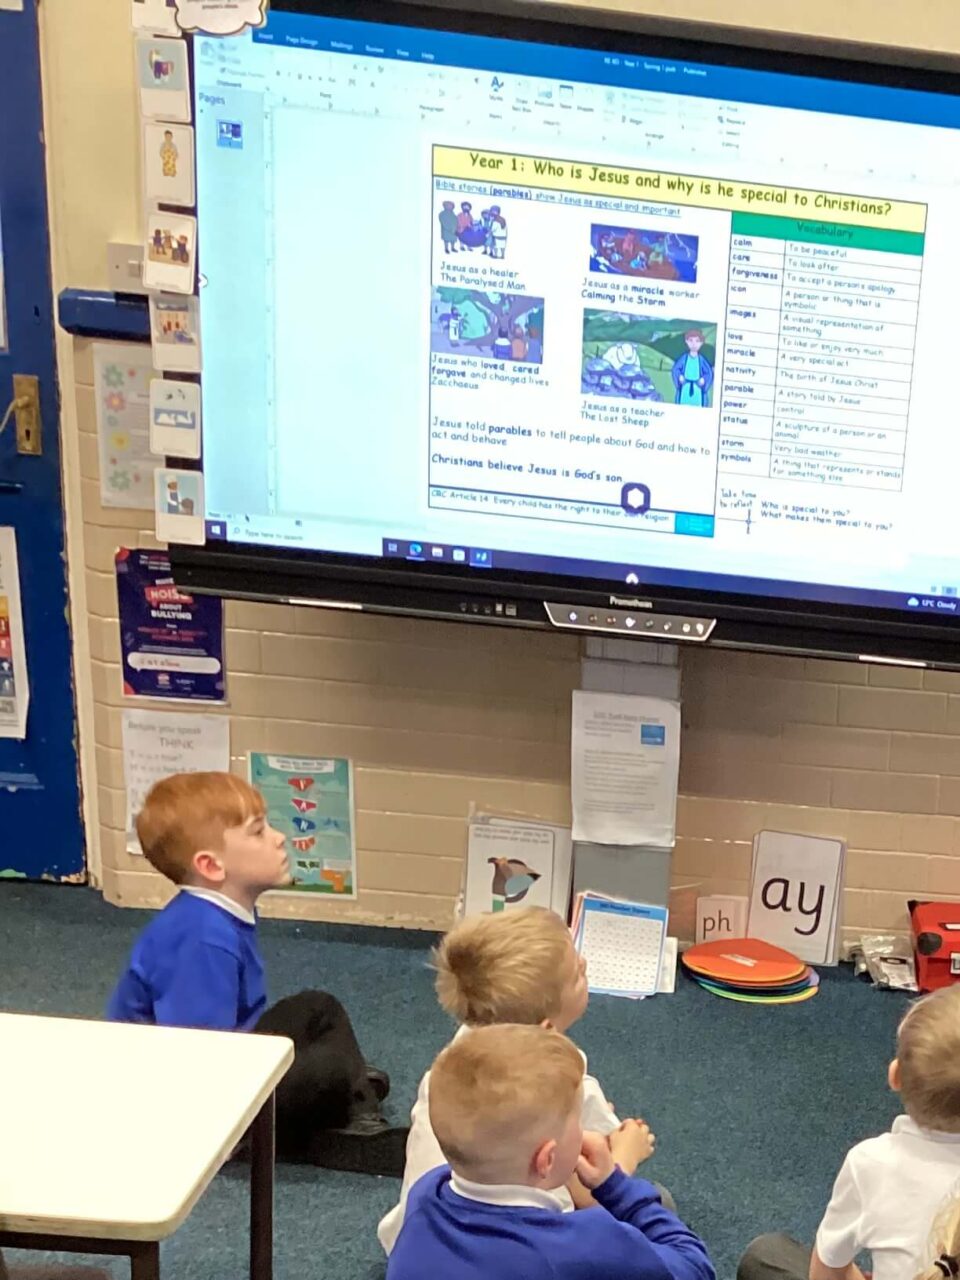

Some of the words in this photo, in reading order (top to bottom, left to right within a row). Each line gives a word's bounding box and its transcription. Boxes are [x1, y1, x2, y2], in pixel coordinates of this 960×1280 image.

[200, 93, 225, 106] Pages
[470, 152, 503, 169] Year
[511, 158, 524, 172] 1:
[534, 160, 563, 176] Who
[571, 165, 582, 179] is
[588, 167, 629, 184] Jesus
[636, 175, 660, 188] and
[667, 177, 694, 196] why
[700, 182, 711, 195] is
[718, 182, 733, 197] he
[741, 188, 787, 204] special
[794, 193, 807, 206] to
[814, 195, 892, 216] Christians?
[436, 180, 455, 189] Bible
[459, 182, 487, 193] stories
[560, 194, 581, 204] Jesus
[595, 200, 622, 210] special
[623, 203, 639, 211] and
[797, 222, 854, 240] Vocabulary
[734, 239, 752, 248] calm
[440, 261, 466, 272] Jesus
[490, 266, 518, 278] healer
[732, 268, 778, 281] forgiveness
[441, 273, 456, 283] The
[460, 274, 503, 288] Paralysed
[507, 280, 526, 290] Man
[582, 278, 606, 289] Jesus
[632, 285, 664, 296] miracle
[670, 290, 700, 299] worker
[581, 289, 615, 304] Calming
[618, 294, 633, 303] the
[637, 296, 665, 307] Storm
[432, 354, 458, 364] Jesus
[461, 358, 478, 367] who
[727, 348, 756, 357] miracle
[432, 366, 466, 378] forgave
[470, 370, 487, 380] and
[489, 373, 526, 385] changed
[529, 376, 549, 386] lives
[726, 366, 756, 376] nativity
[432, 377, 479, 390] Zacchaeus
[724, 384, 754, 394] parable
[582, 401, 606, 411] Jesus
[631, 407, 664, 417] teacher
[724, 400, 746, 409] power
[581, 411, 596, 420] The
[600, 412, 618, 422] Lost
[622, 416, 649, 427] Sheep
[723, 416, 748, 424] status
[432, 430, 447, 439] act
[451, 432, 468, 442] and
[472, 436, 507, 446] behave
[433, 416, 462, 428] Jesus
[466, 421, 486, 431] told
[488, 424, 532, 436] parables
[536, 429, 546, 438] to
[550, 430, 566, 440] tell
[570, 434, 600, 444] people
[604, 436, 632, 447] about
[636, 438, 654, 450] God
[658, 442, 674, 452] and
[678, 444, 696, 454] how
[701, 447, 710, 455] to
[722, 439, 744, 448] storm
[432, 454, 483, 468] Christians
[488, 460, 522, 472] believe
[528, 464, 556, 476] Jesus
[562, 468, 570, 477] is
[575, 470, 602, 481] God's
[151, 610, 192, 620] BULLYING
[160, 737, 194, 750] THINK
[762, 876, 825, 936] ay
[702, 910, 732, 938] ph
